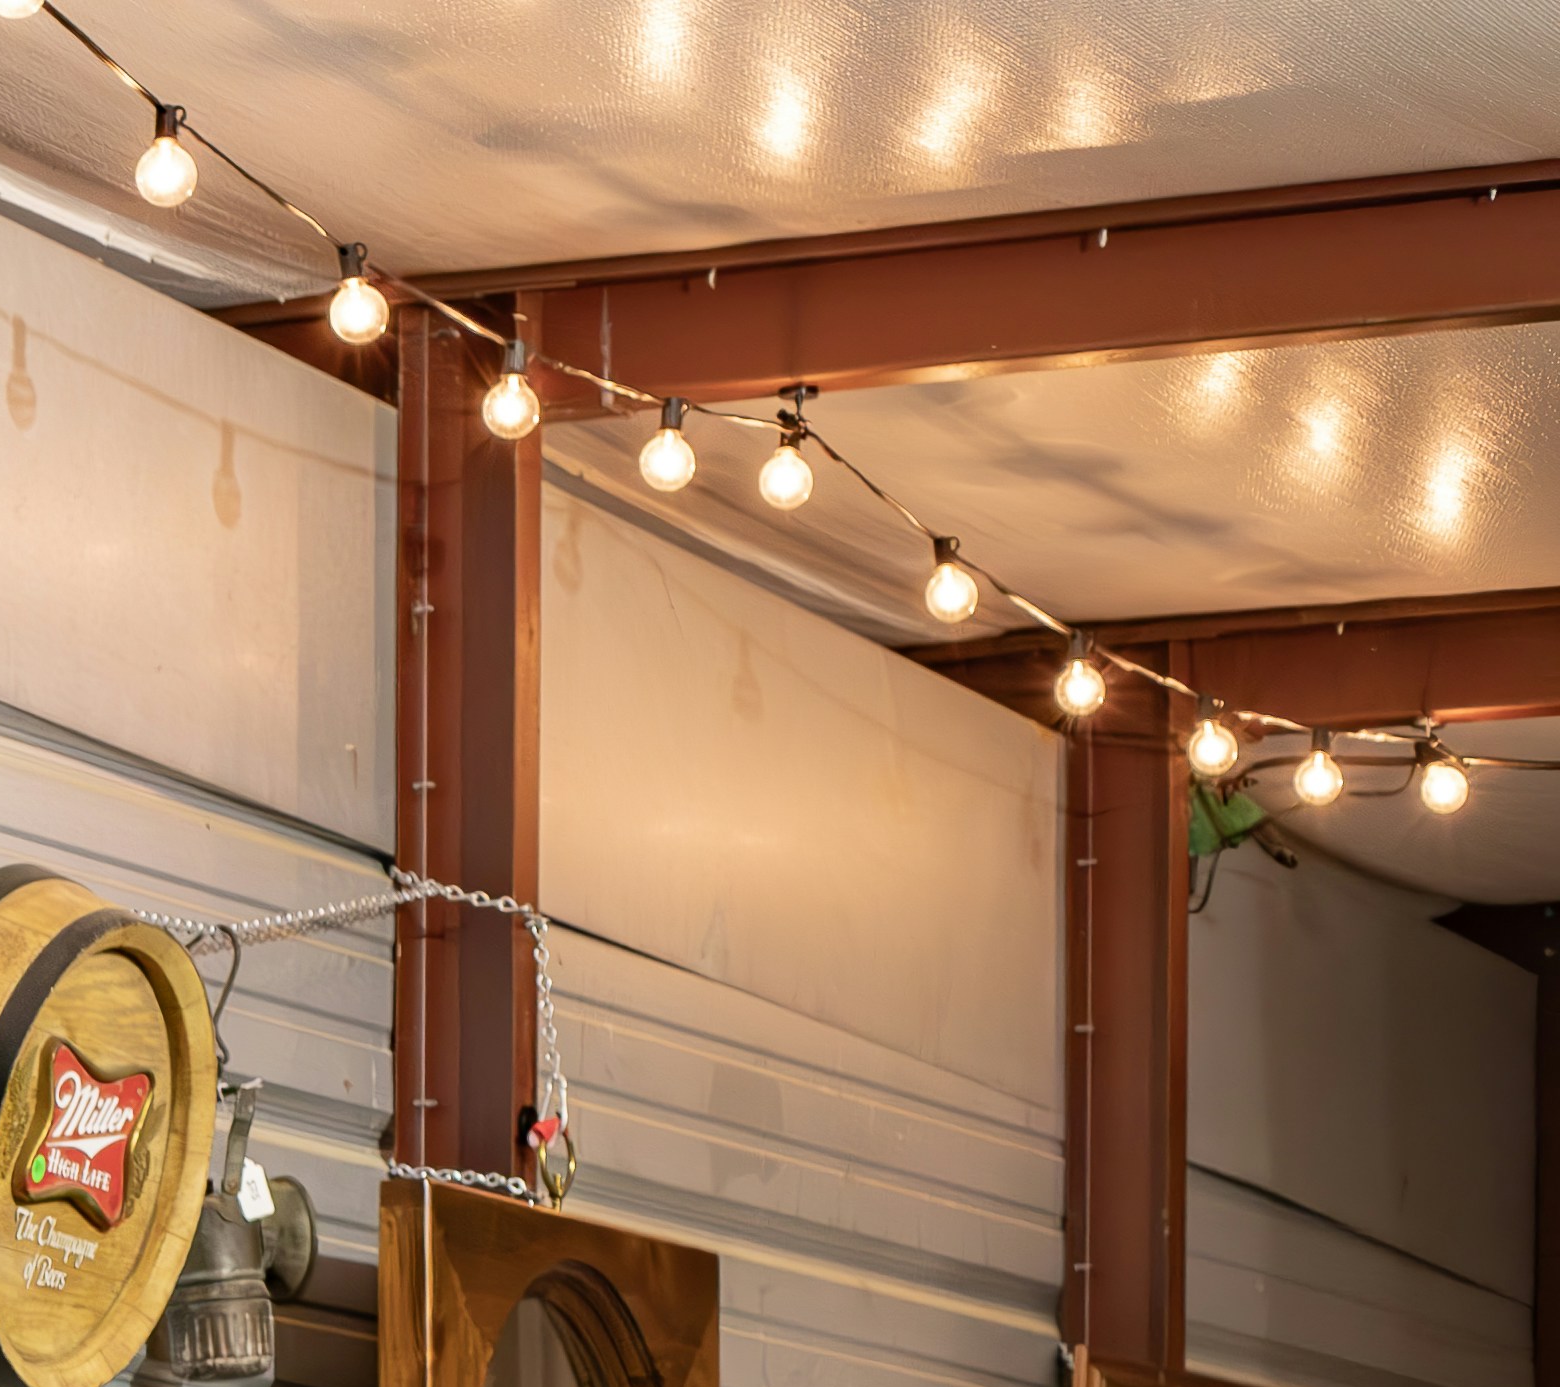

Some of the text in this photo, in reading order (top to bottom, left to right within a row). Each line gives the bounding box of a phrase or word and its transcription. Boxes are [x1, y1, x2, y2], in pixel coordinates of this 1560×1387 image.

[52, 1070, 135, 1140] Miller
[46, 1147, 113, 1193] HIGH LIFE
[14, 1206, 99, 1272] The Champagne
[22, 1252, 69, 1291] of Beers
